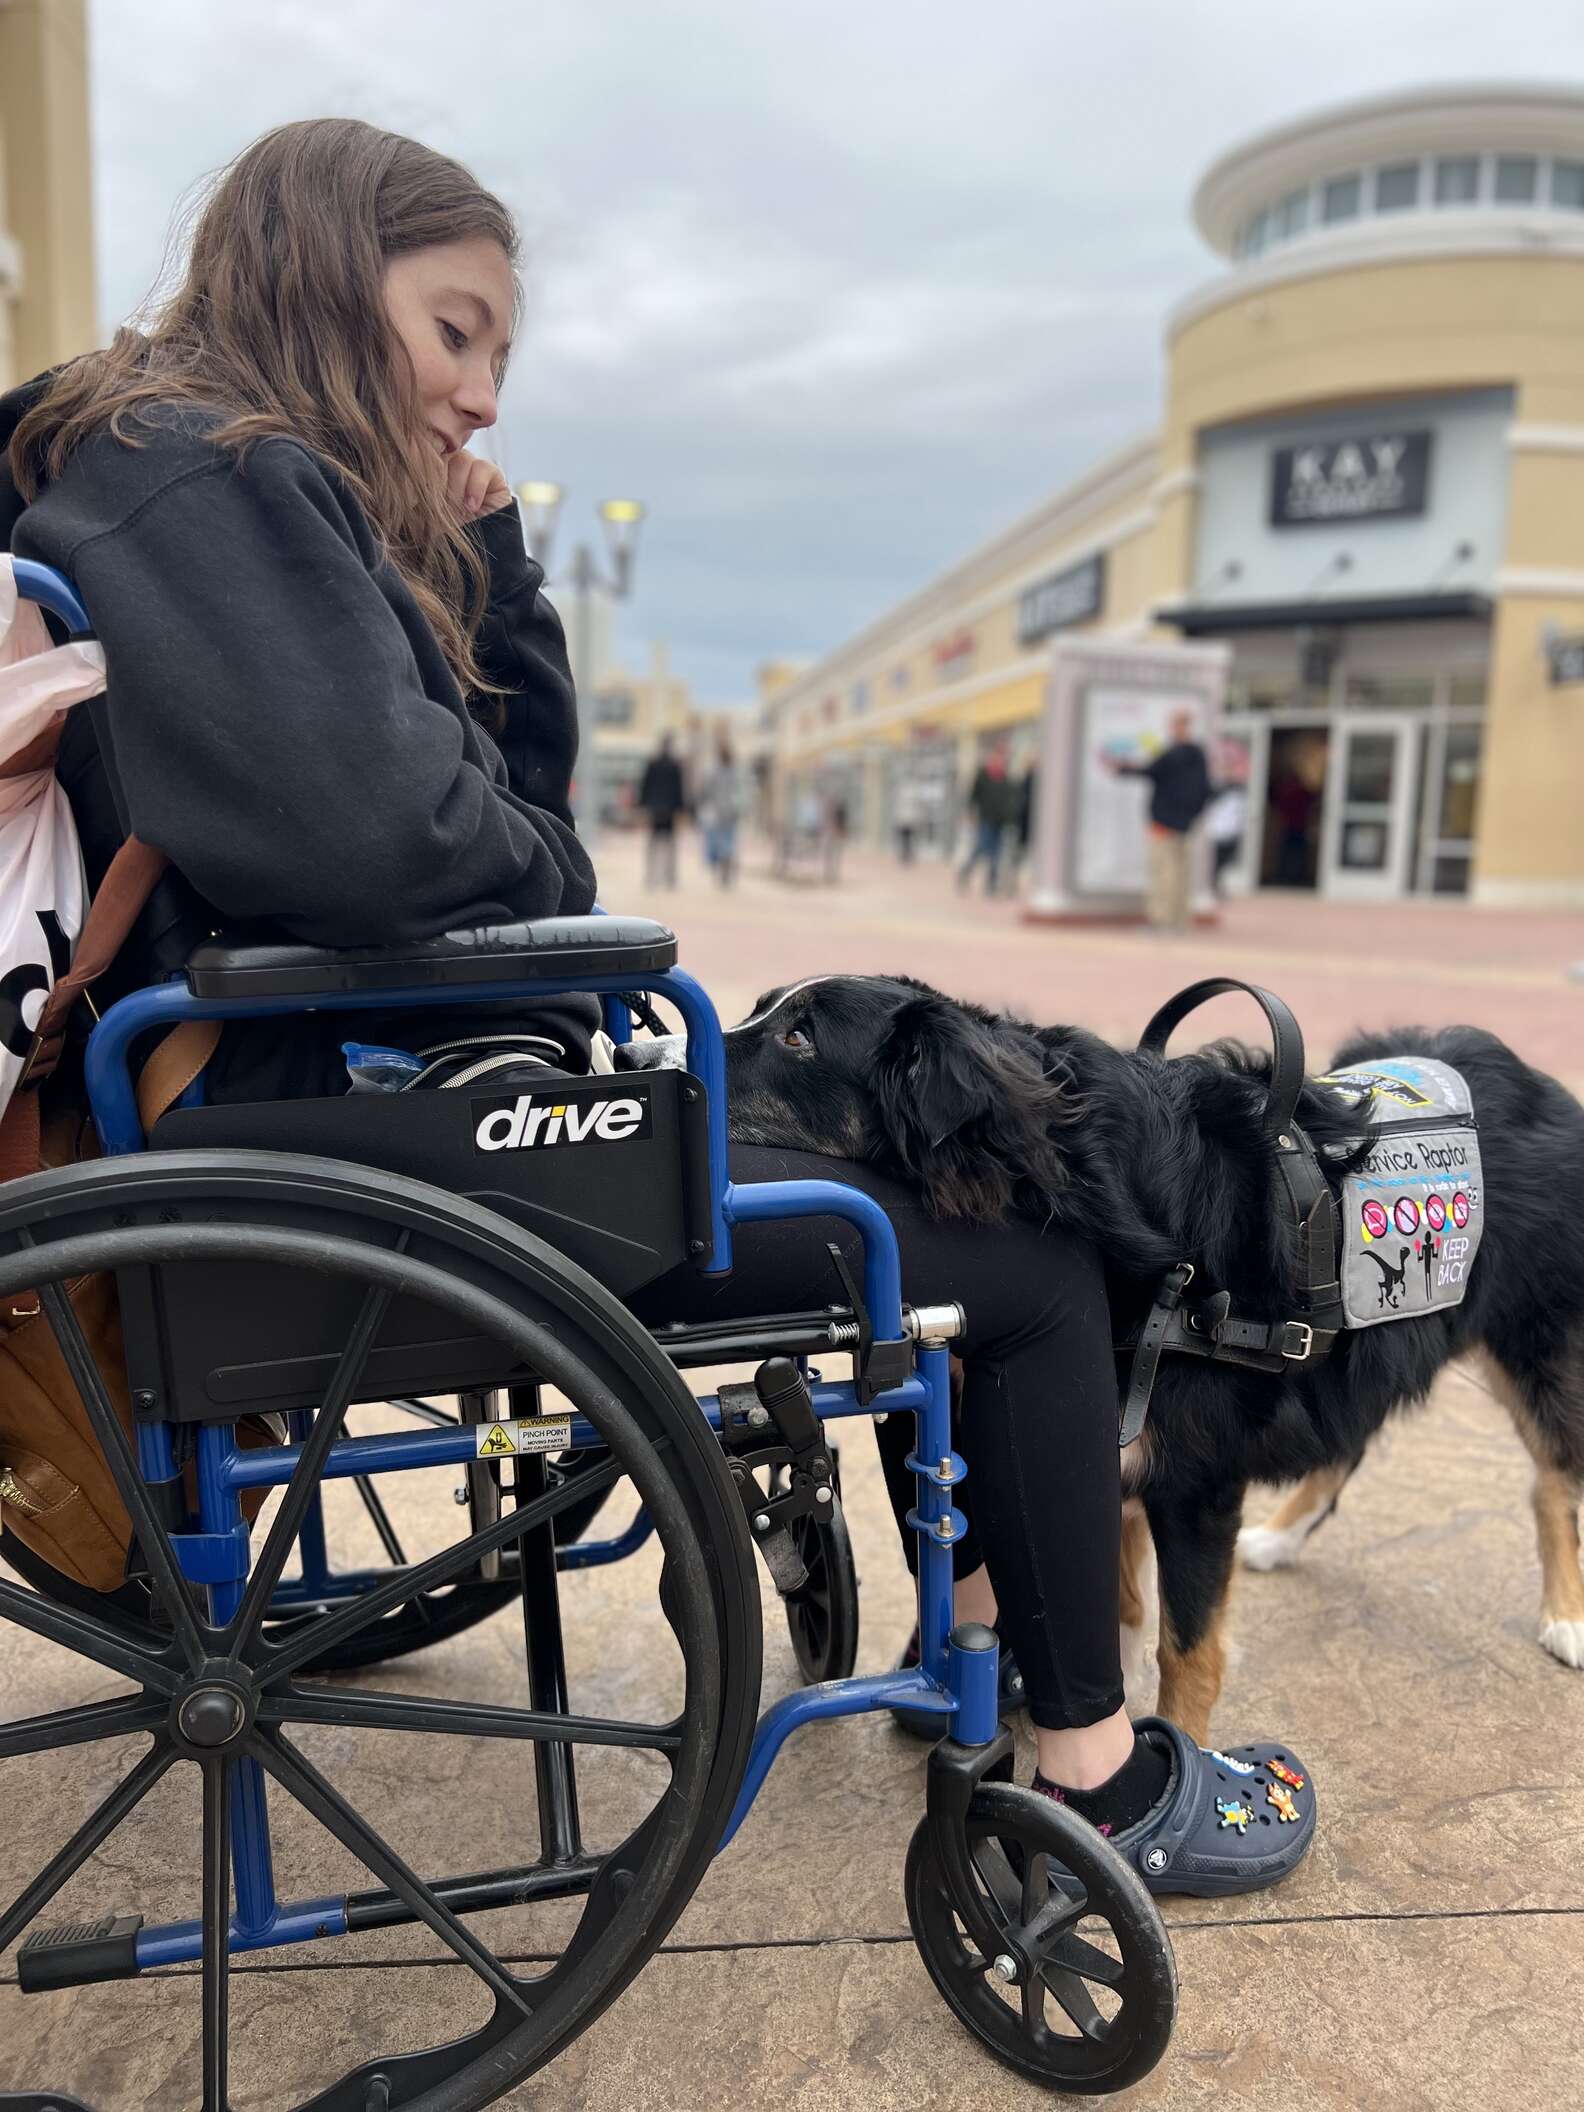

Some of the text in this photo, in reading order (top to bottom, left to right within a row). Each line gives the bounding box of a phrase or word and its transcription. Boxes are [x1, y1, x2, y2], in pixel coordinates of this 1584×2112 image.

[1291, 439, 1406, 490] KAY
[475, 1095, 643, 1151] drive
[1416, 1143, 1469, 1173] Raptor
[1442, 1237, 1470, 1262] KEEP
[1437, 1261, 1467, 1287] BACK
[523, 1428, 568, 1438] PINCH POINT
[531, 1416, 568, 1425] WARNING
